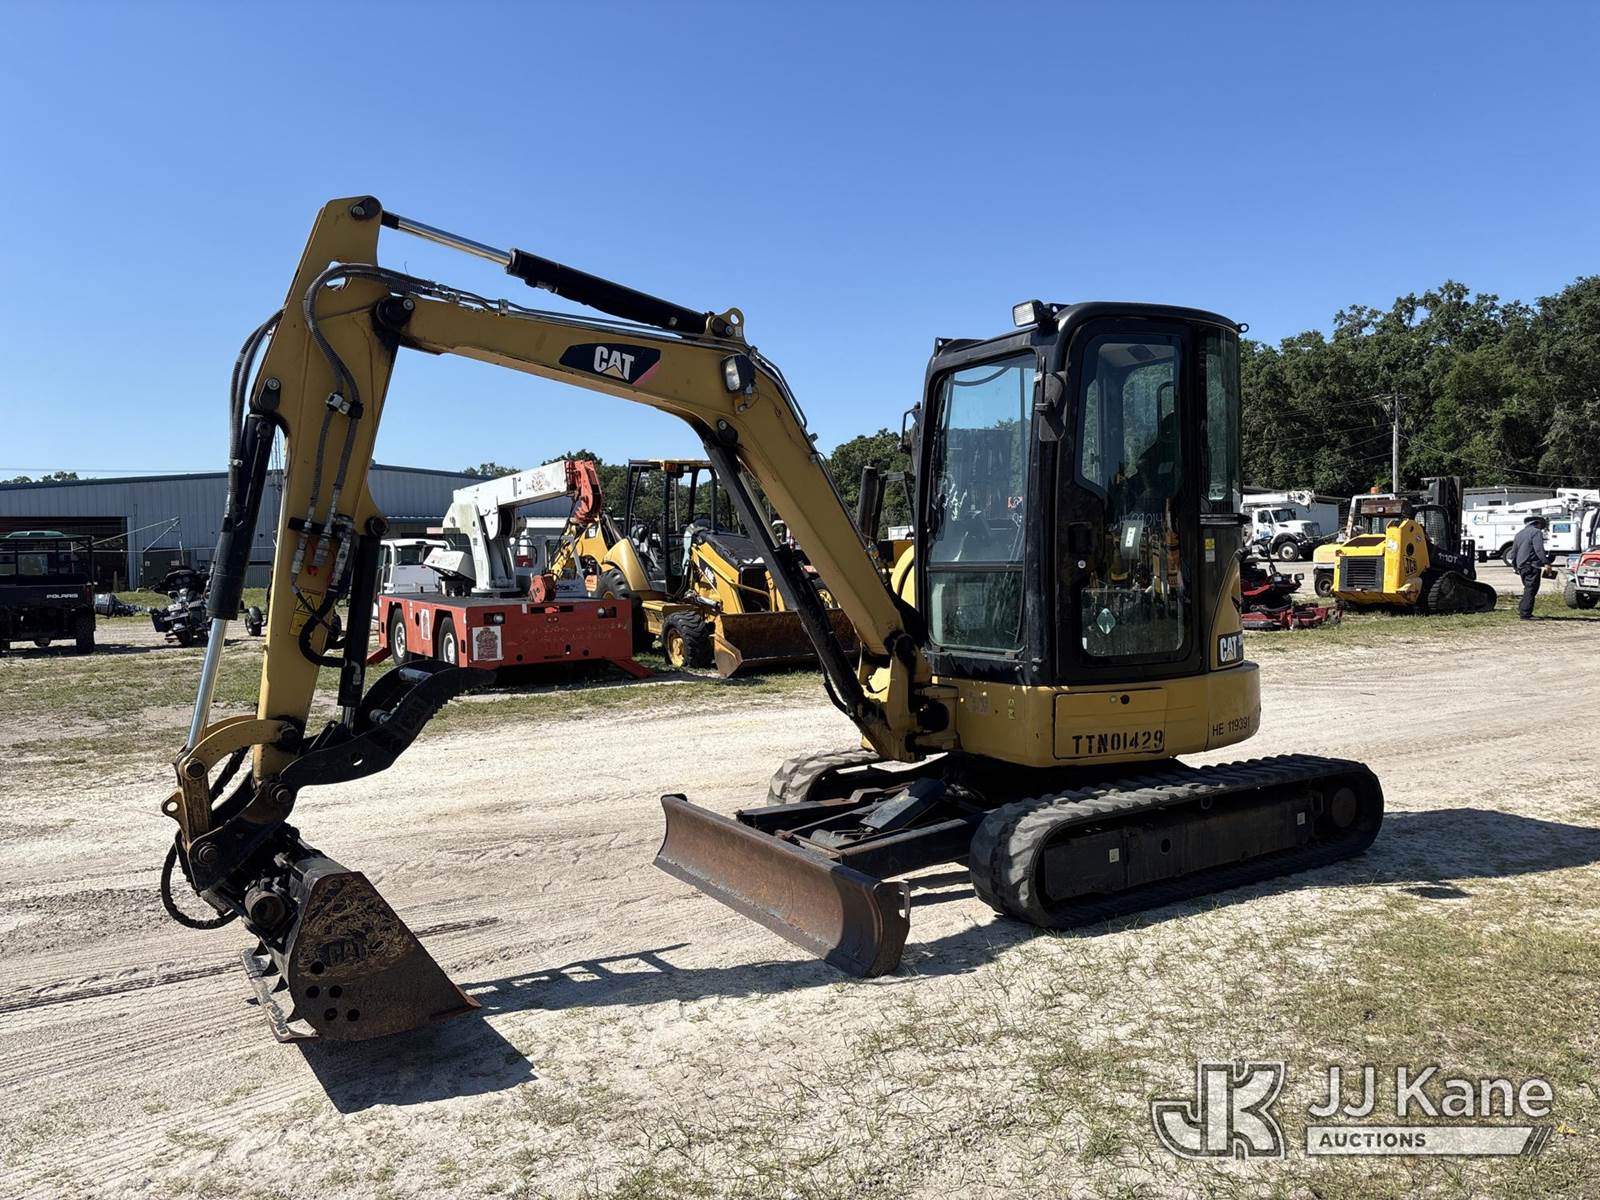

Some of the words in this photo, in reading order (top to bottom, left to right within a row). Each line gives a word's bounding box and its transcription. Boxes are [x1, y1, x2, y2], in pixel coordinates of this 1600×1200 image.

[593, 346, 635, 380] CAT
[1219, 636, 1237, 662] CAT
[1072, 730, 1164, 754] TTN01429
[1212, 723, 1224, 736] HE
